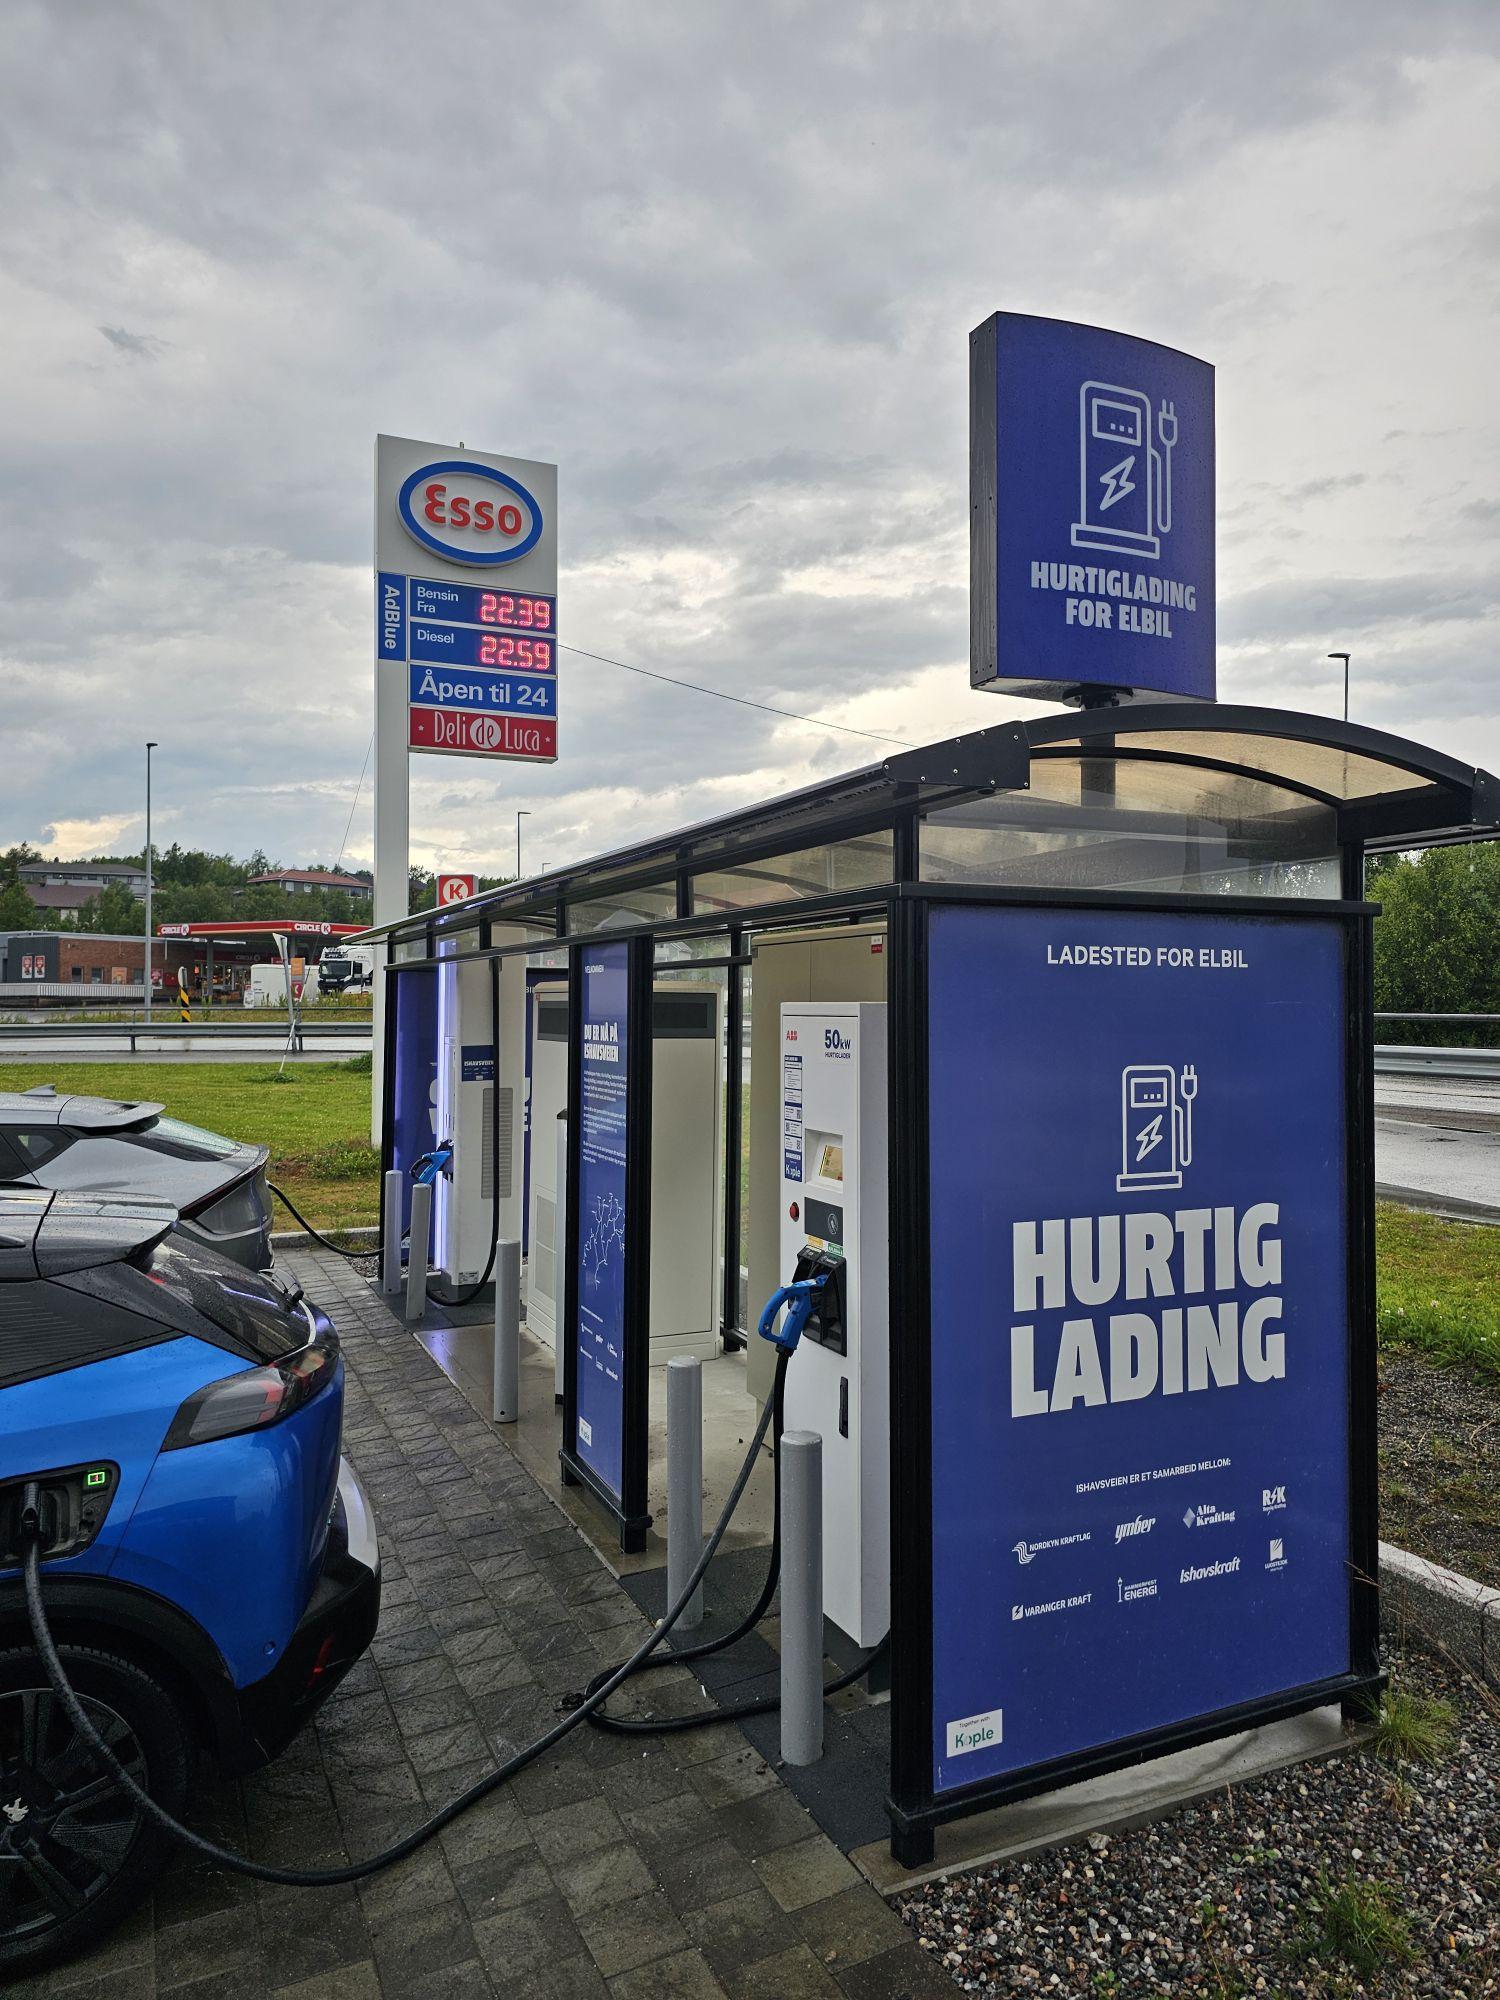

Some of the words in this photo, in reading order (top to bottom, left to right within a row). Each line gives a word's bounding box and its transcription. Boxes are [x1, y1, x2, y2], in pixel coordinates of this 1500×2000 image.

[1030, 561, 1197, 612] HURTIGLADING
[384, 584, 401, 650] AdBlue
[416, 601, 436, 613] Fra
[416, 586, 459, 602] Bensin
[480, 593, 551, 629] 22.39
[1065, 597, 1112, 629] FOR
[1118, 608, 1173, 639] ELBIL
[416, 629, 455, 644] Diesel
[480, 635, 551, 671] 22.59
[418, 669, 484, 702] Åpen
[488, 682, 511, 704] til
[517, 684, 549, 708] 24
[434, 711, 467, 747] Deli
[475, 717, 495, 748] de
[504, 719, 541, 752] Luca
[294, 923, 320, 932] CIRCLE
[1047, 944, 1151, 966] LADESTED
[1157, 947, 1194, 967] FOR
[1199, 949, 1248, 968] ELBIL
[786, 1030, 798, 1041] ABB
[1012, 1202, 1282, 1313] HURTIG
[1010, 1296, 1286, 1419] LADING
[1076, 1476, 1128, 1493] ISHAVSVEIEN
[1130, 1474, 1140, 1484] ER
[1142, 1472, 1151, 1481] ET
[1152, 1463, 1196, 1479] SAMARBEID
[1198, 1458, 1232, 1471] MELLOM:
[1196, 1504, 1216, 1516] Alta
[1196, 1510, 1236, 1527] Kraftlag
[1030, 1538, 1060, 1552] NORDKYN
[1060, 1532, 1091, 1545] KRAFTLAG
[1114, 1514, 1156, 1545] ymber
[1179, 1556, 1240, 1584] Ishavskraft
[1024, 1600, 1066, 1617] VARANGER
[1067, 1593, 1092, 1608] KRAFT
[1124, 1584, 1158, 1600] ENERGI
